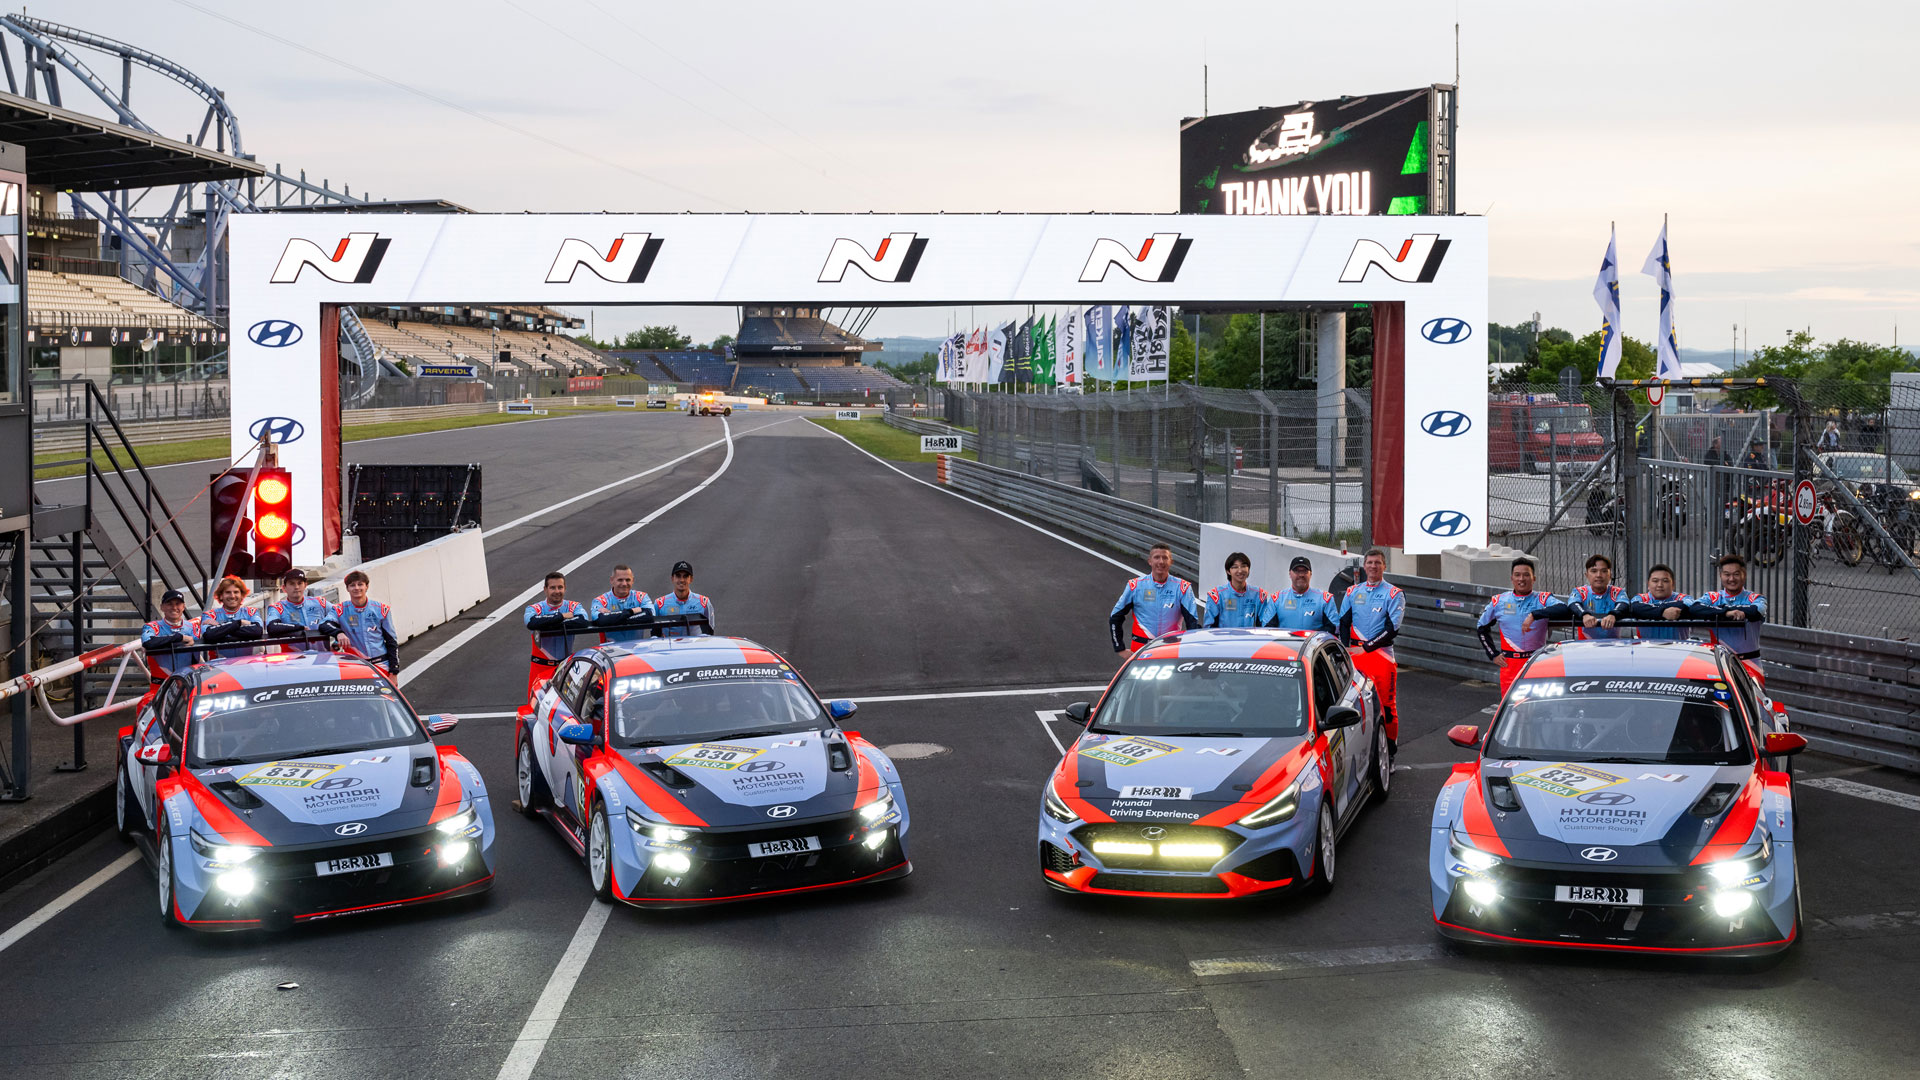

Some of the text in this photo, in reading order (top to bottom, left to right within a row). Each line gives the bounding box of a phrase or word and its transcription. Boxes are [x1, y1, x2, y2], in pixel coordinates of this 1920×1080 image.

[1221, 171, 1370, 215] THANK YOU
[1208, 662, 1242, 670] GRAN
[697, 669, 727, 677] GRAN
[1130, 666, 1175, 680] 486
[286, 686, 319, 696] GRAN
[614, 677, 660, 696] 24h
[1512, 682, 1564, 700] 24h
[1605, 681, 1643, 689] GRAN
[196, 695, 246, 716] 24h
[694, 750, 738, 761] 830
[1112, 742, 1150, 758] 486
[686, 759, 727, 769] DEKRA
[1097, 751, 1130, 765] DEKRA
[266, 767, 315, 779] 831
[733, 772, 803, 785] HYUNDAI
[1540, 769, 1588, 786] 832
[258, 778, 302, 787] DEKRA
[736, 778, 805, 792] MOTORSPORT
[1529, 779, 1569, 796] DEKRA
[303, 788, 380, 803] HYUNDAI
[744, 788, 778, 797] Customer
[1131, 787, 1161, 796] H&R
[306, 795, 381, 809] MOTORSPORT
[312, 805, 350, 814] Customer
[1110, 809, 1199, 820] Driving Experience
[1561, 808, 1646, 819] HYUNDAI
[1560, 817, 1645, 826] MOTORSPORT
[1564, 824, 1606, 832] Customer
[760, 841, 790, 854] H&R
[329, 858, 360, 872] H&R
[1569, 886, 1604, 900] H&R
